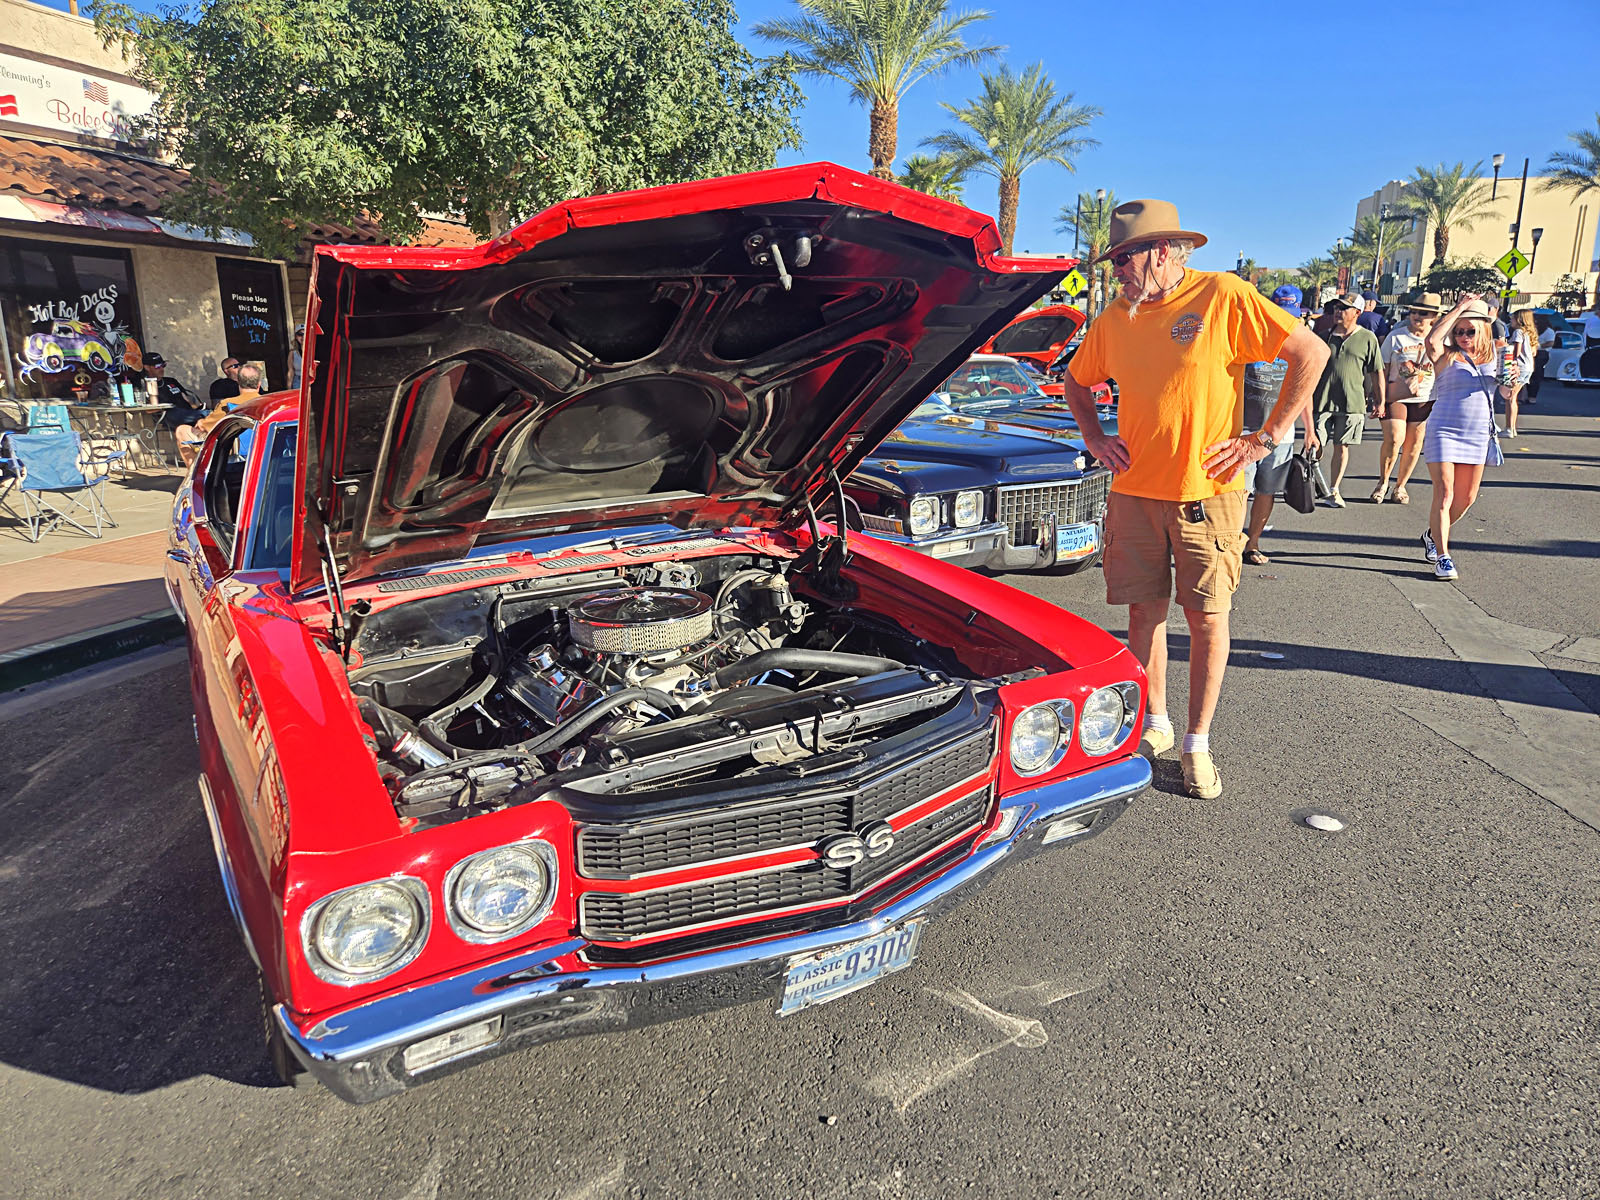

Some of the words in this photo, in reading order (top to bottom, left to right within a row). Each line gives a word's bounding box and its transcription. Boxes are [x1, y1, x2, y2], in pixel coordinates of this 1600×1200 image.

[0, 65, 51, 88] lemming's
[28, 301, 56, 323] Hot
[59, 300, 80, 321] Rod
[81, 284, 118, 312] Days
[231, 293, 254, 302] Please
[254, 295, 268, 303] Use
[252, 305, 269, 313] Door
[230, 314, 271, 331] Welcome
[821, 823, 895, 869] SS
[786, 959, 843, 986] CLASSIC
[784, 974, 841, 1000] VEHICLE
